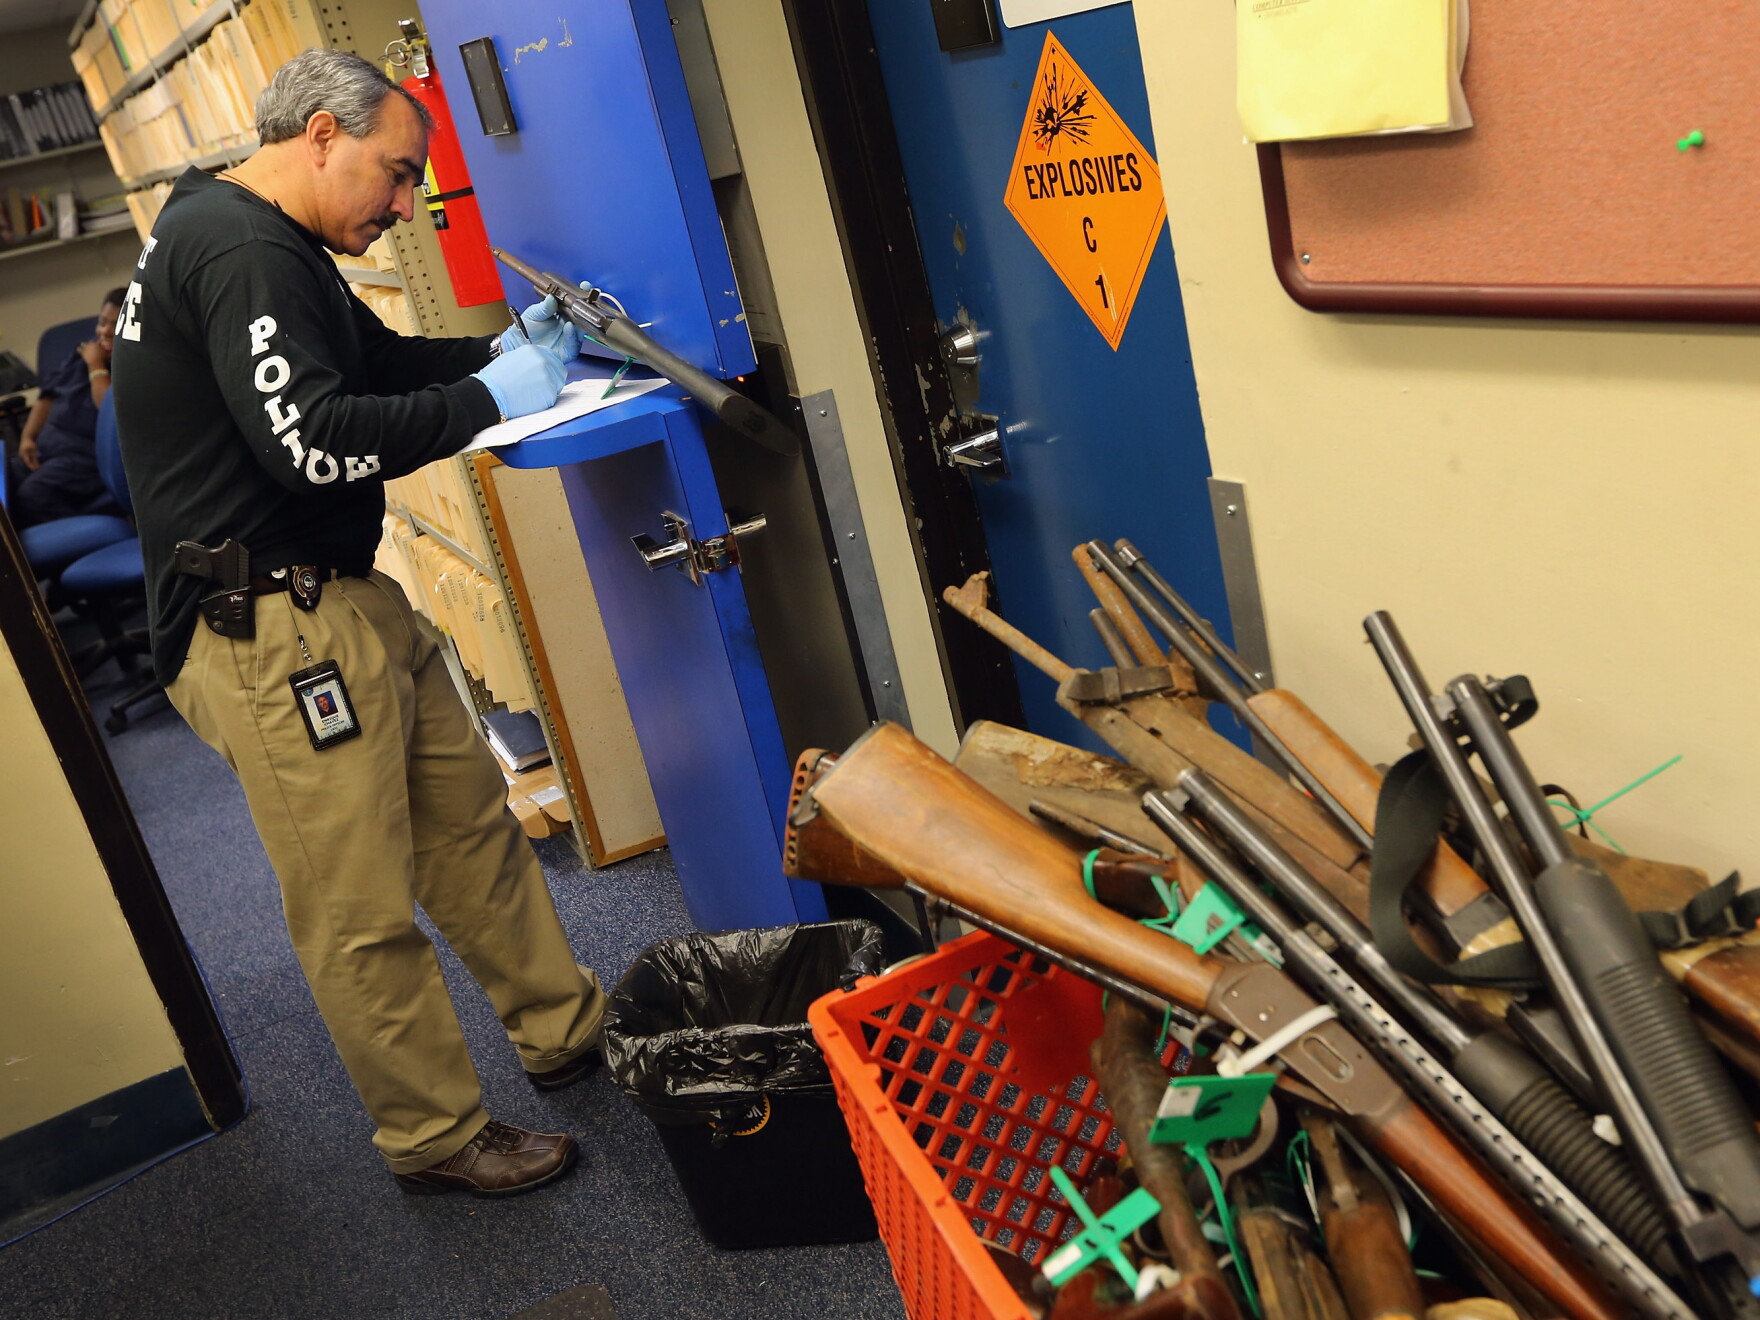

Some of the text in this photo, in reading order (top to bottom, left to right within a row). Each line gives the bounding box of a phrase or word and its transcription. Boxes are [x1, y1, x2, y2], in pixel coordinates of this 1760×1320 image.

[1024, 152, 1142, 200] EXPLOSIVES
[1082, 216, 1097, 253] C
[1095, 274, 1109, 309] 1
[249, 315, 381, 485] POLICE
